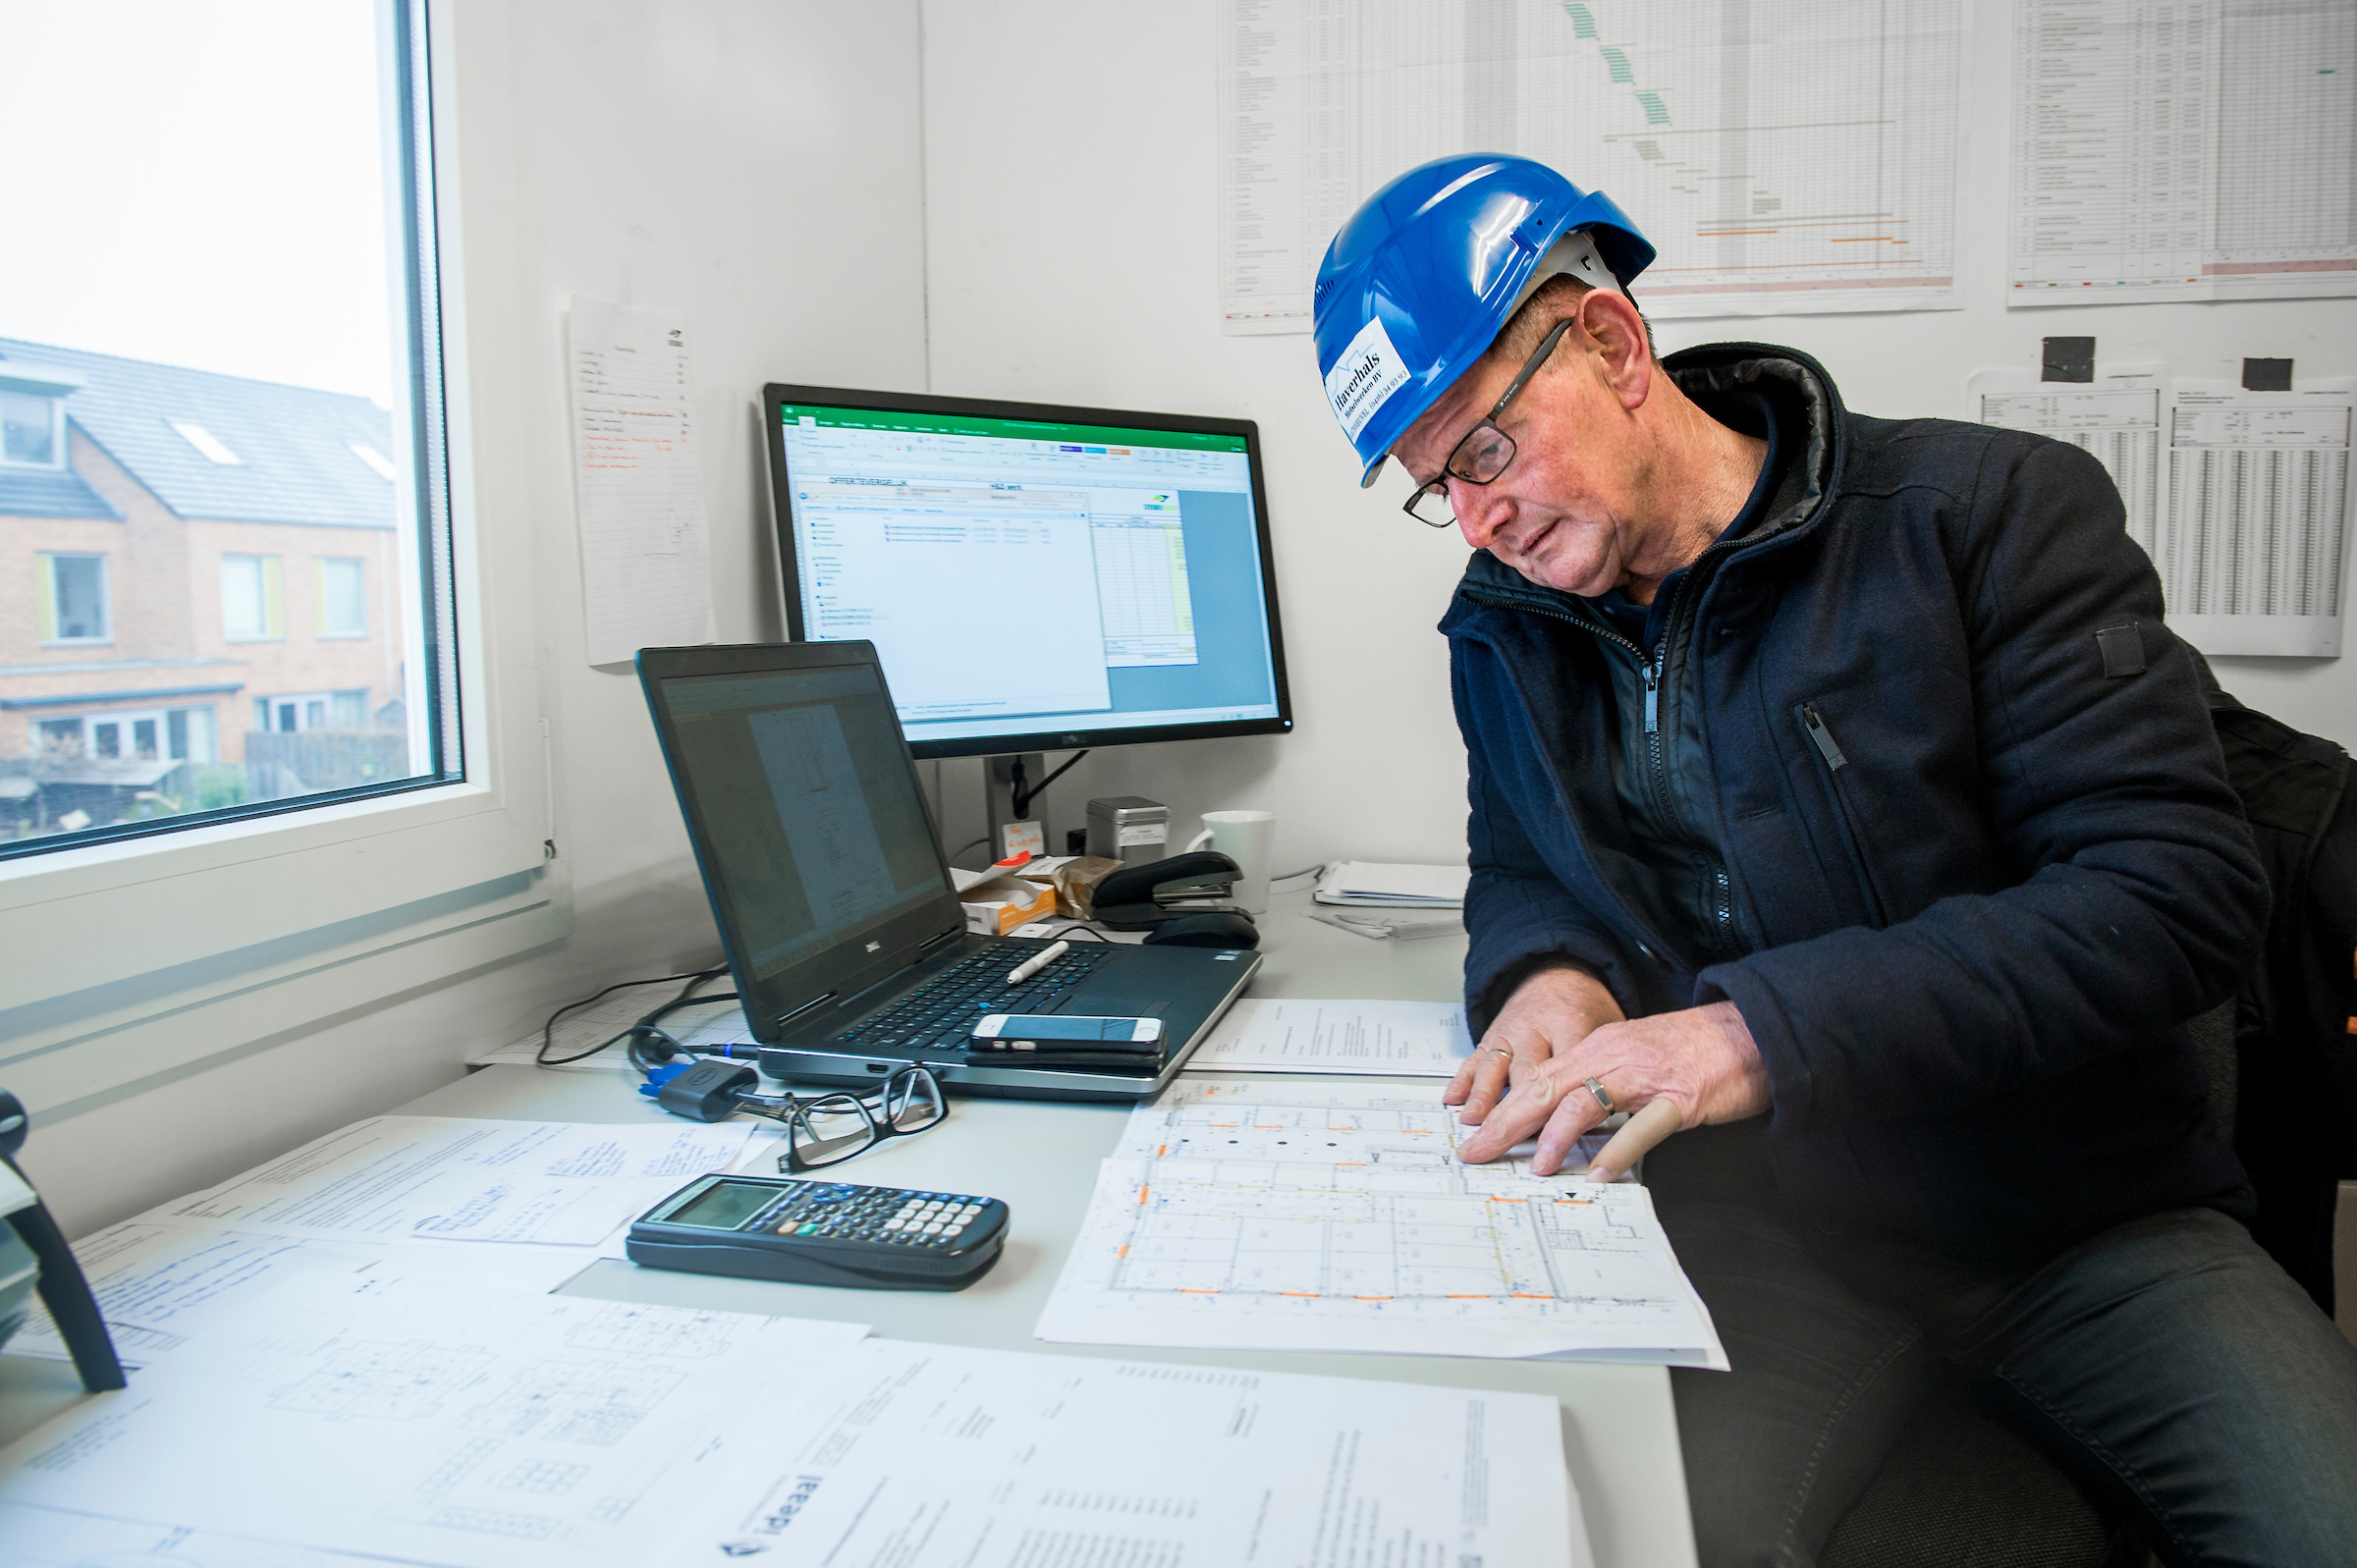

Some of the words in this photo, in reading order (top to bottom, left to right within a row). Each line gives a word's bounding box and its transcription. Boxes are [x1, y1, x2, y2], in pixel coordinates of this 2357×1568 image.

[1336, 352, 1380, 412] Haverhals
[1344, 382, 1374, 419] Metselwerken
[1372, 369, 1382, 383] BV
[1369, 390, 1385, 410] (0416)
[1382, 384, 1392, 396] 34
[1390, 377, 1399, 388] 93
[1398, 369, 1407, 381] 93
[753, 1474, 824, 1536] ideaal
